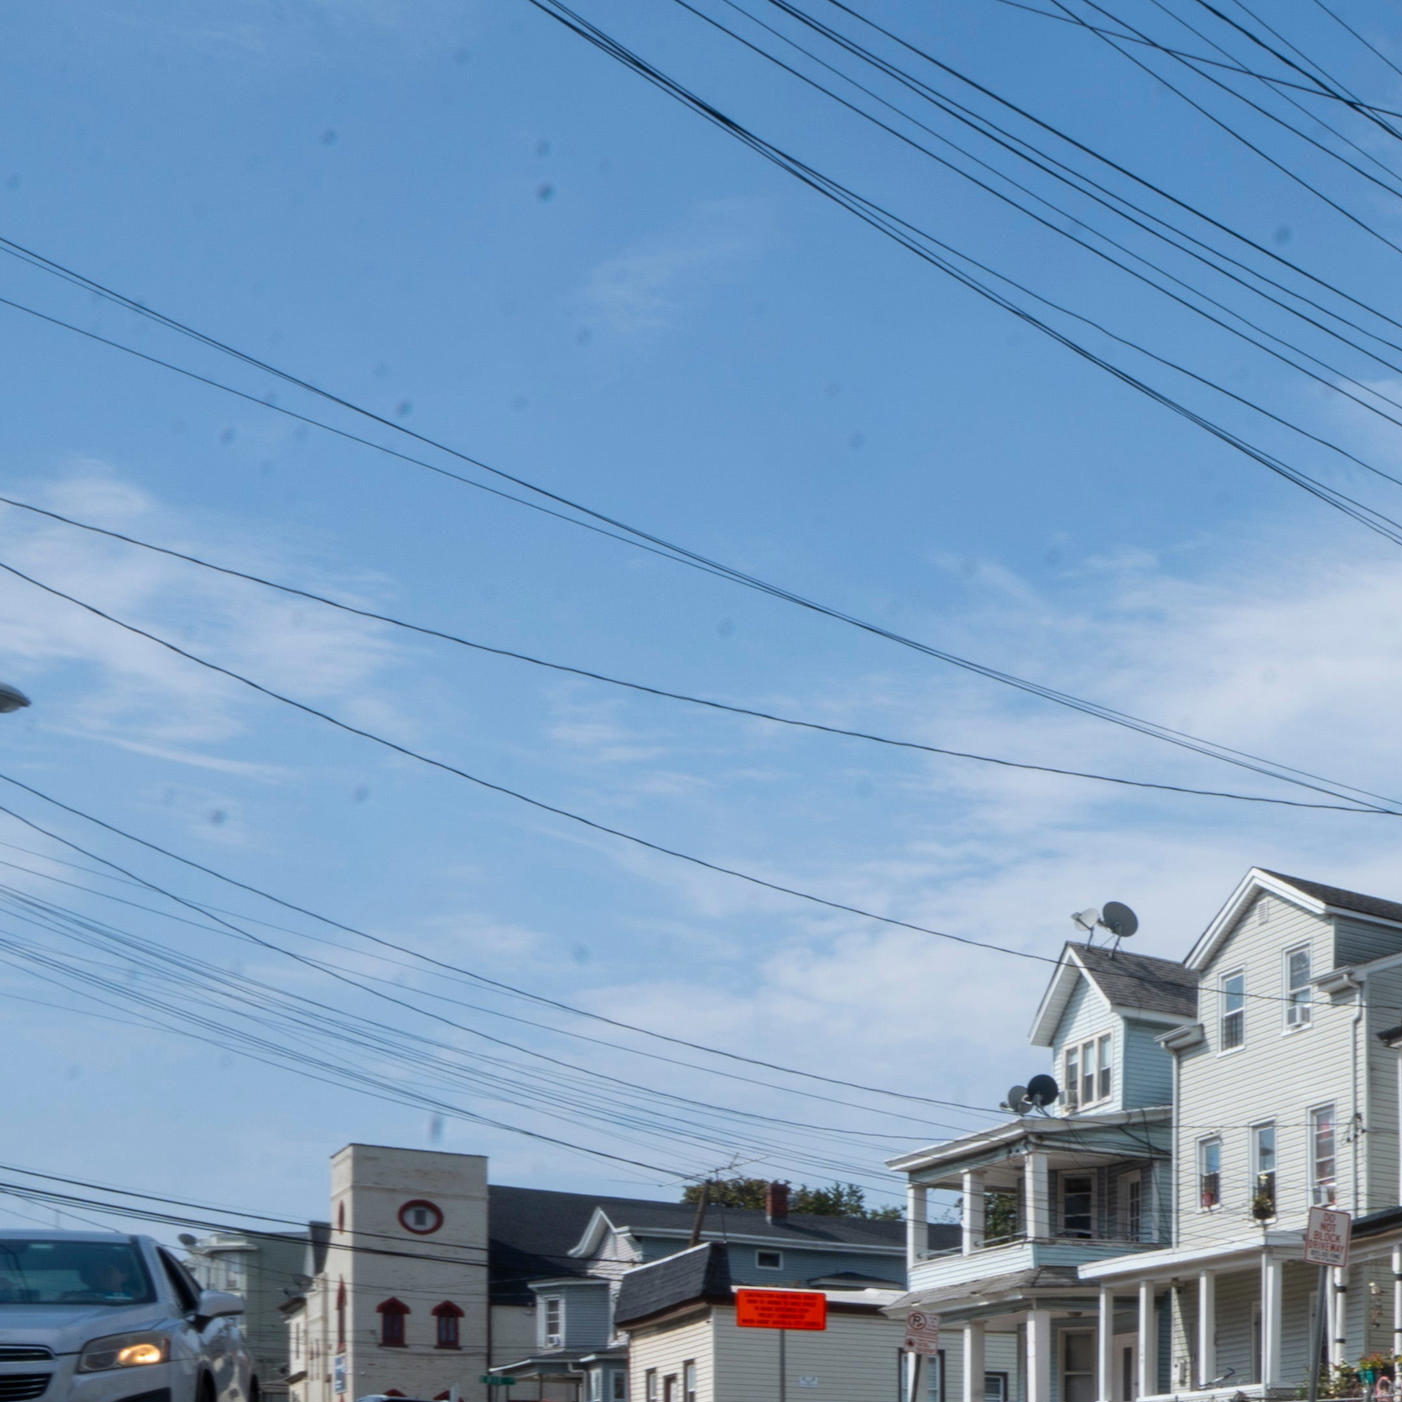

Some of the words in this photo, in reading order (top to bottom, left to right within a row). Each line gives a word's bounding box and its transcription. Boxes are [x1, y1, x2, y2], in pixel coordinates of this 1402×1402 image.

[1323, 1213, 1336, 1223] DO
[1320, 1222, 1337, 1233] NOT
[1313, 1231, 1341, 1243] BLOCK
[1308, 1240, 1345, 1254] DRIVEWAY
